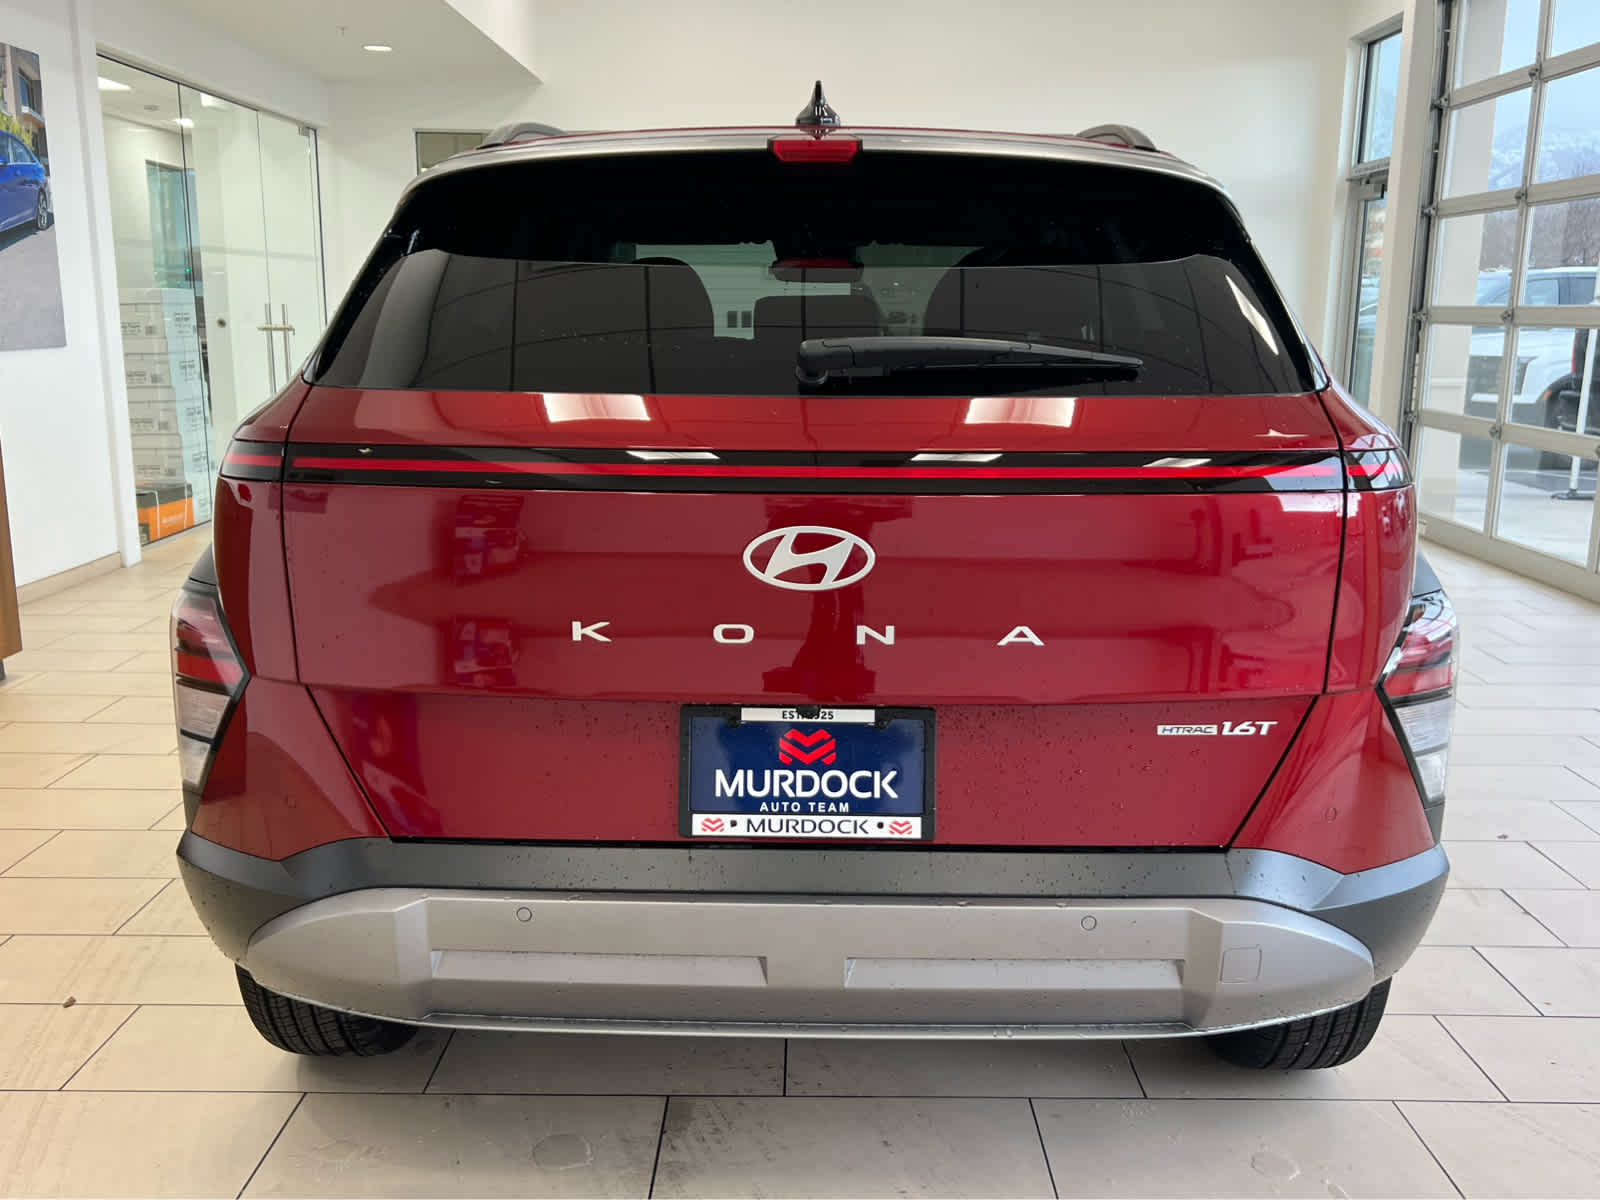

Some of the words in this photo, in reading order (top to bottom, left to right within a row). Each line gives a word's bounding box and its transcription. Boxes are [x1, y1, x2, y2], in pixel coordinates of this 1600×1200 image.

[572, 621, 1045, 647] KONA
[1160, 726, 1214, 734] HTRAC
[715, 769, 899, 799] MURDOCK
[759, 802, 801, 813] AUTO
[807, 802, 849, 813] TEAM
[746, 819, 869, 834] MURDOCK
